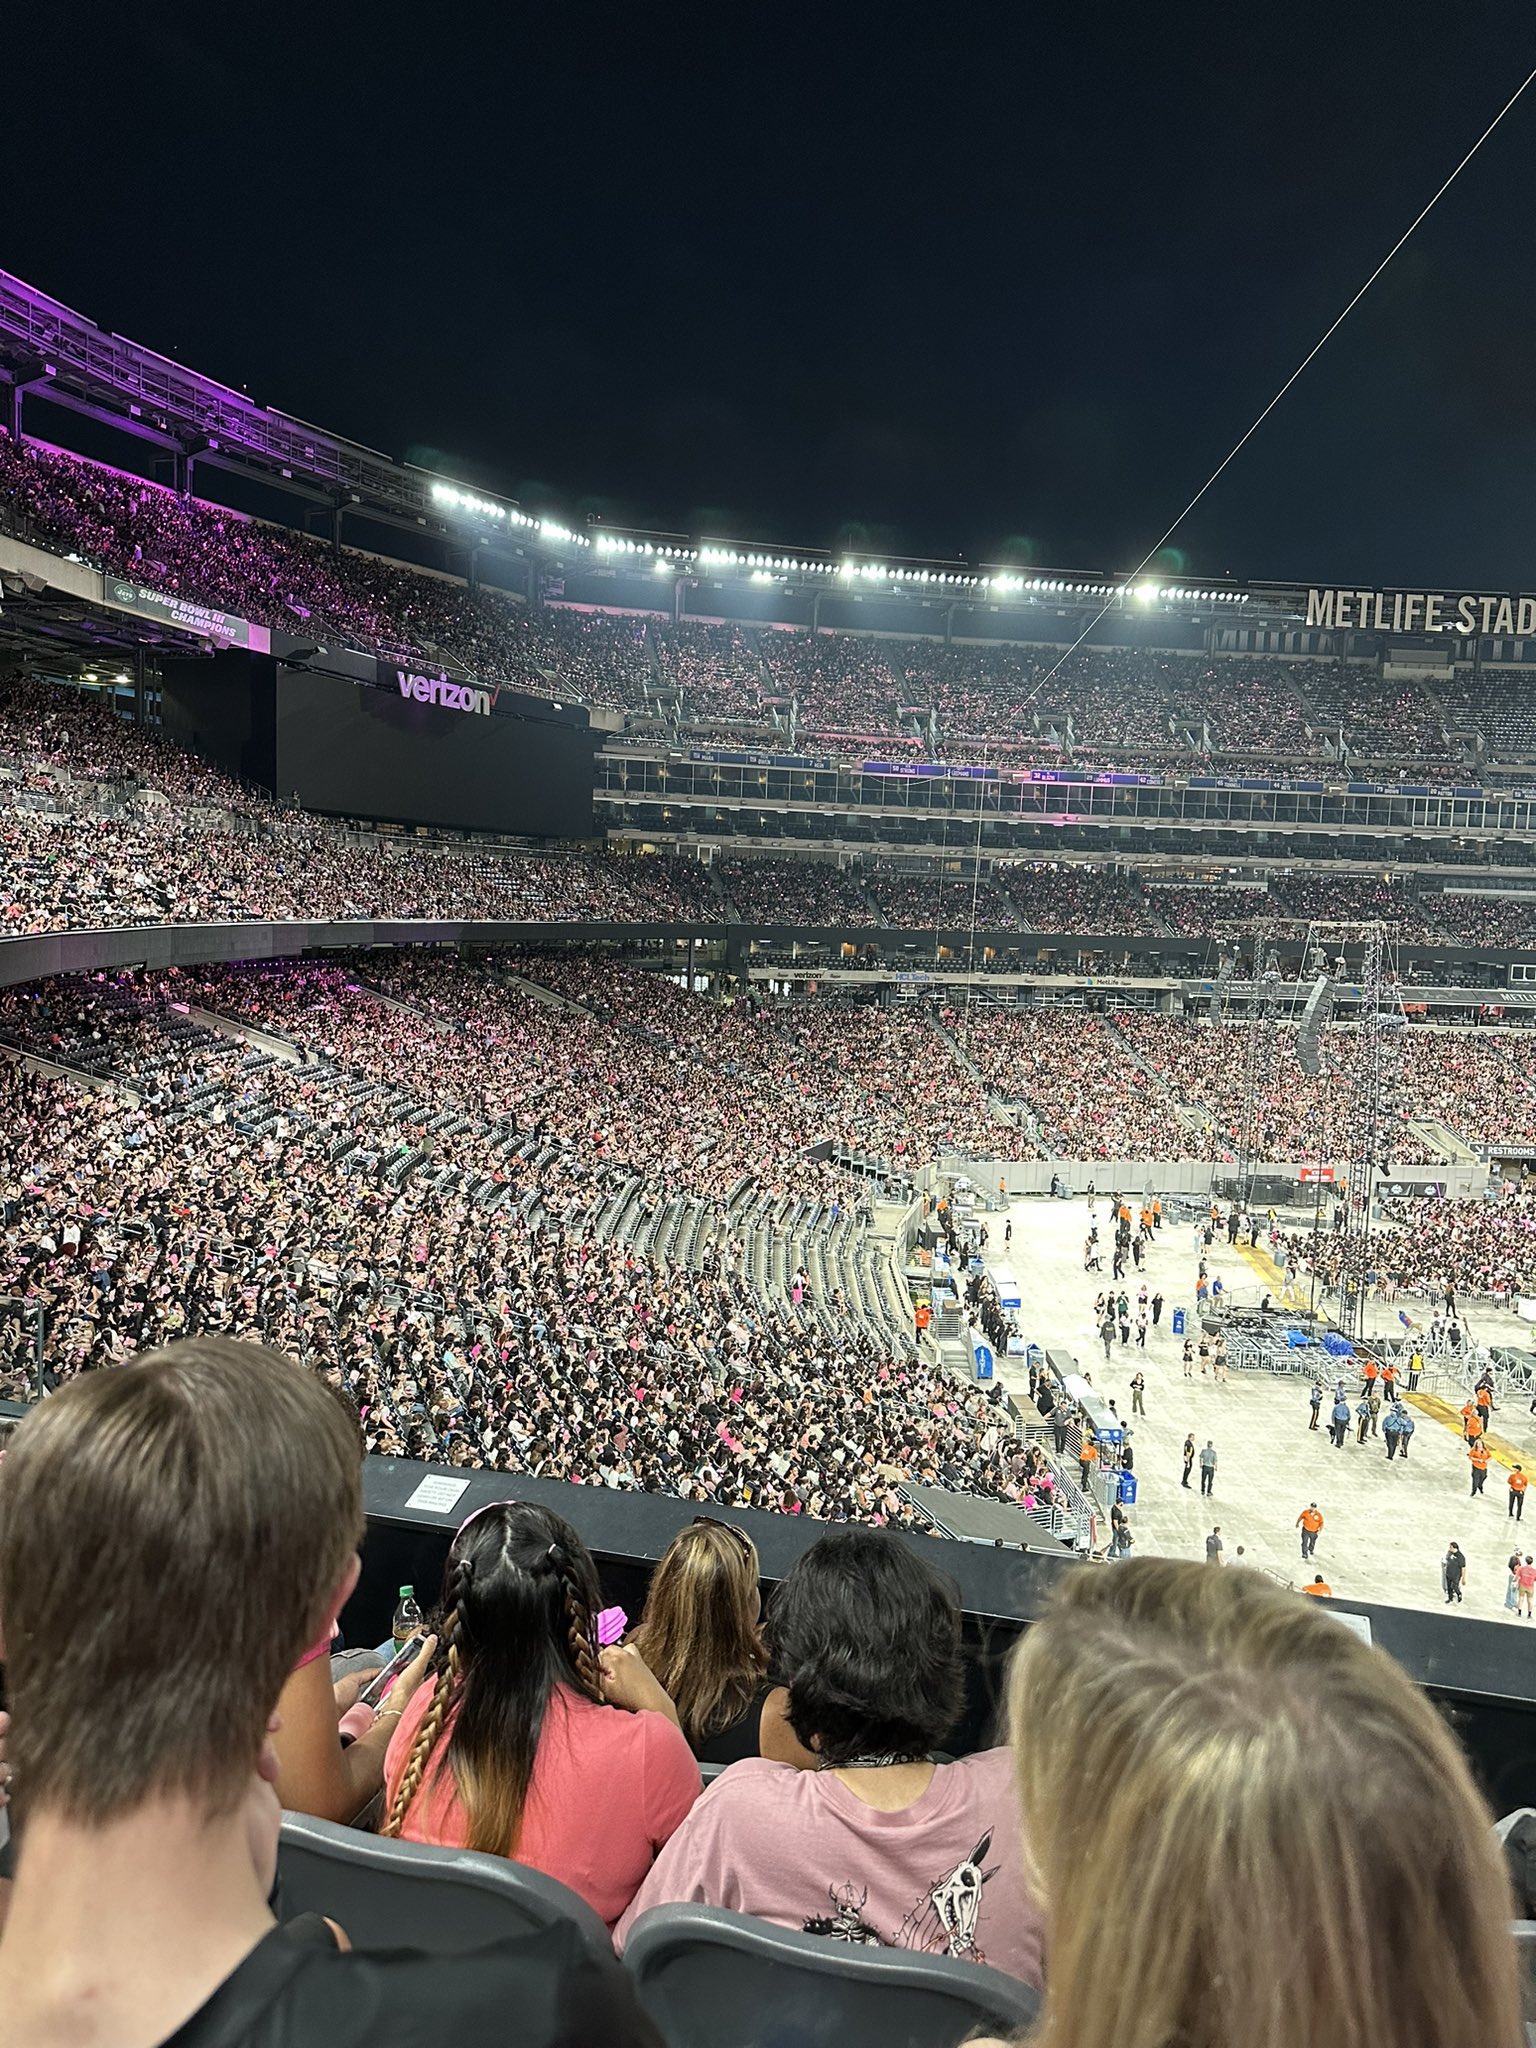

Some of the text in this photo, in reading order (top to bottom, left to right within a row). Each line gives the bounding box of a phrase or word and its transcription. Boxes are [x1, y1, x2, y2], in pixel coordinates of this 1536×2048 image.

[138, 588, 226, 624] SUPER BOWL III
[1305, 588, 1536, 635] METLIFE STAD
[170, 610, 236, 637] CHAMPIONS
[397, 671, 490, 716] verizon
[794, 971, 822, 979] verizon
[1097, 978, 1119, 986] MetLife
[1500, 993, 1536, 1003] METLI
[1488, 1146, 1535, 1156] RESTROOMS
